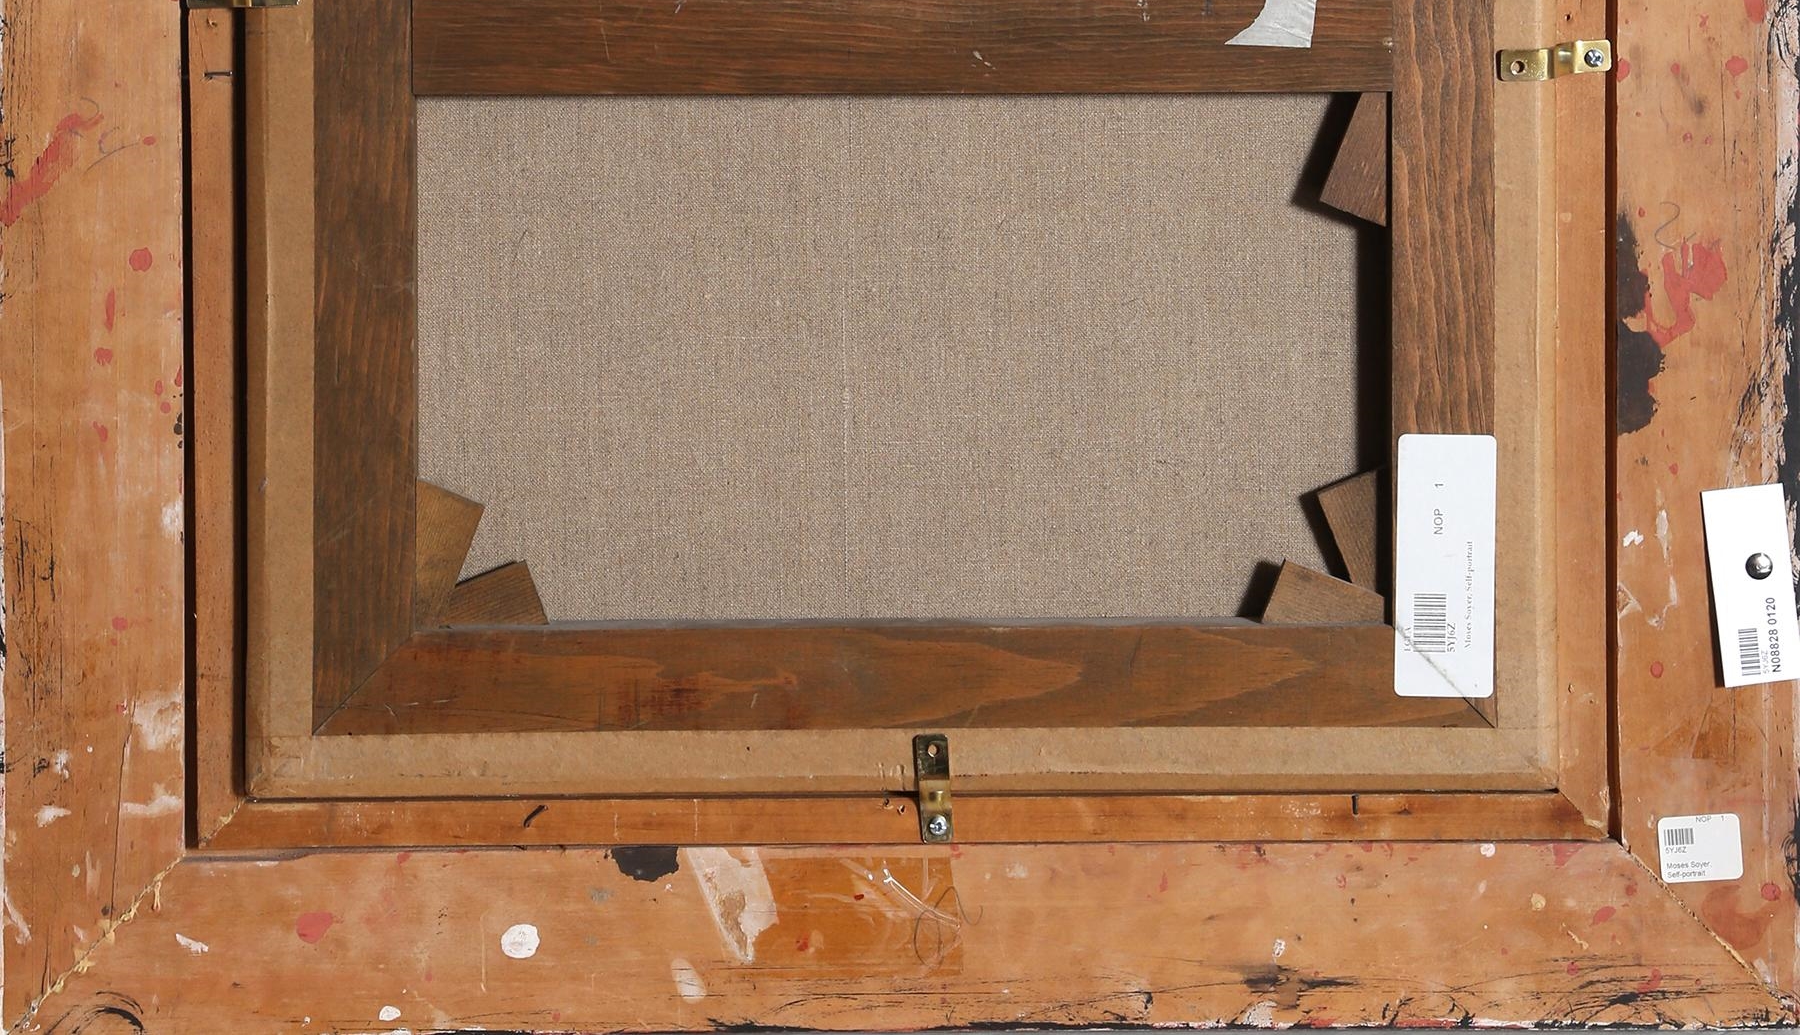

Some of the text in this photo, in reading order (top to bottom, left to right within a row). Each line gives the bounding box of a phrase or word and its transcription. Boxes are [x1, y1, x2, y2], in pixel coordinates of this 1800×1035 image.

[1433, 508, 1444, 535] NOP
[1465, 540, 1475, 592] Self-portrait
[1446, 622, 1456, 653] 5YJ6Z
[1464, 622, 1472, 649] Moses
[1765, 597, 1782, 673] N08828 0120
[1760, 650, 1770, 674] 5YJ6Z
[1695, 815, 1711, 823] NOP
[1665, 846, 1687, 854] 5YJ6Z
[1667, 869, 1706, 879] Self-portrait
